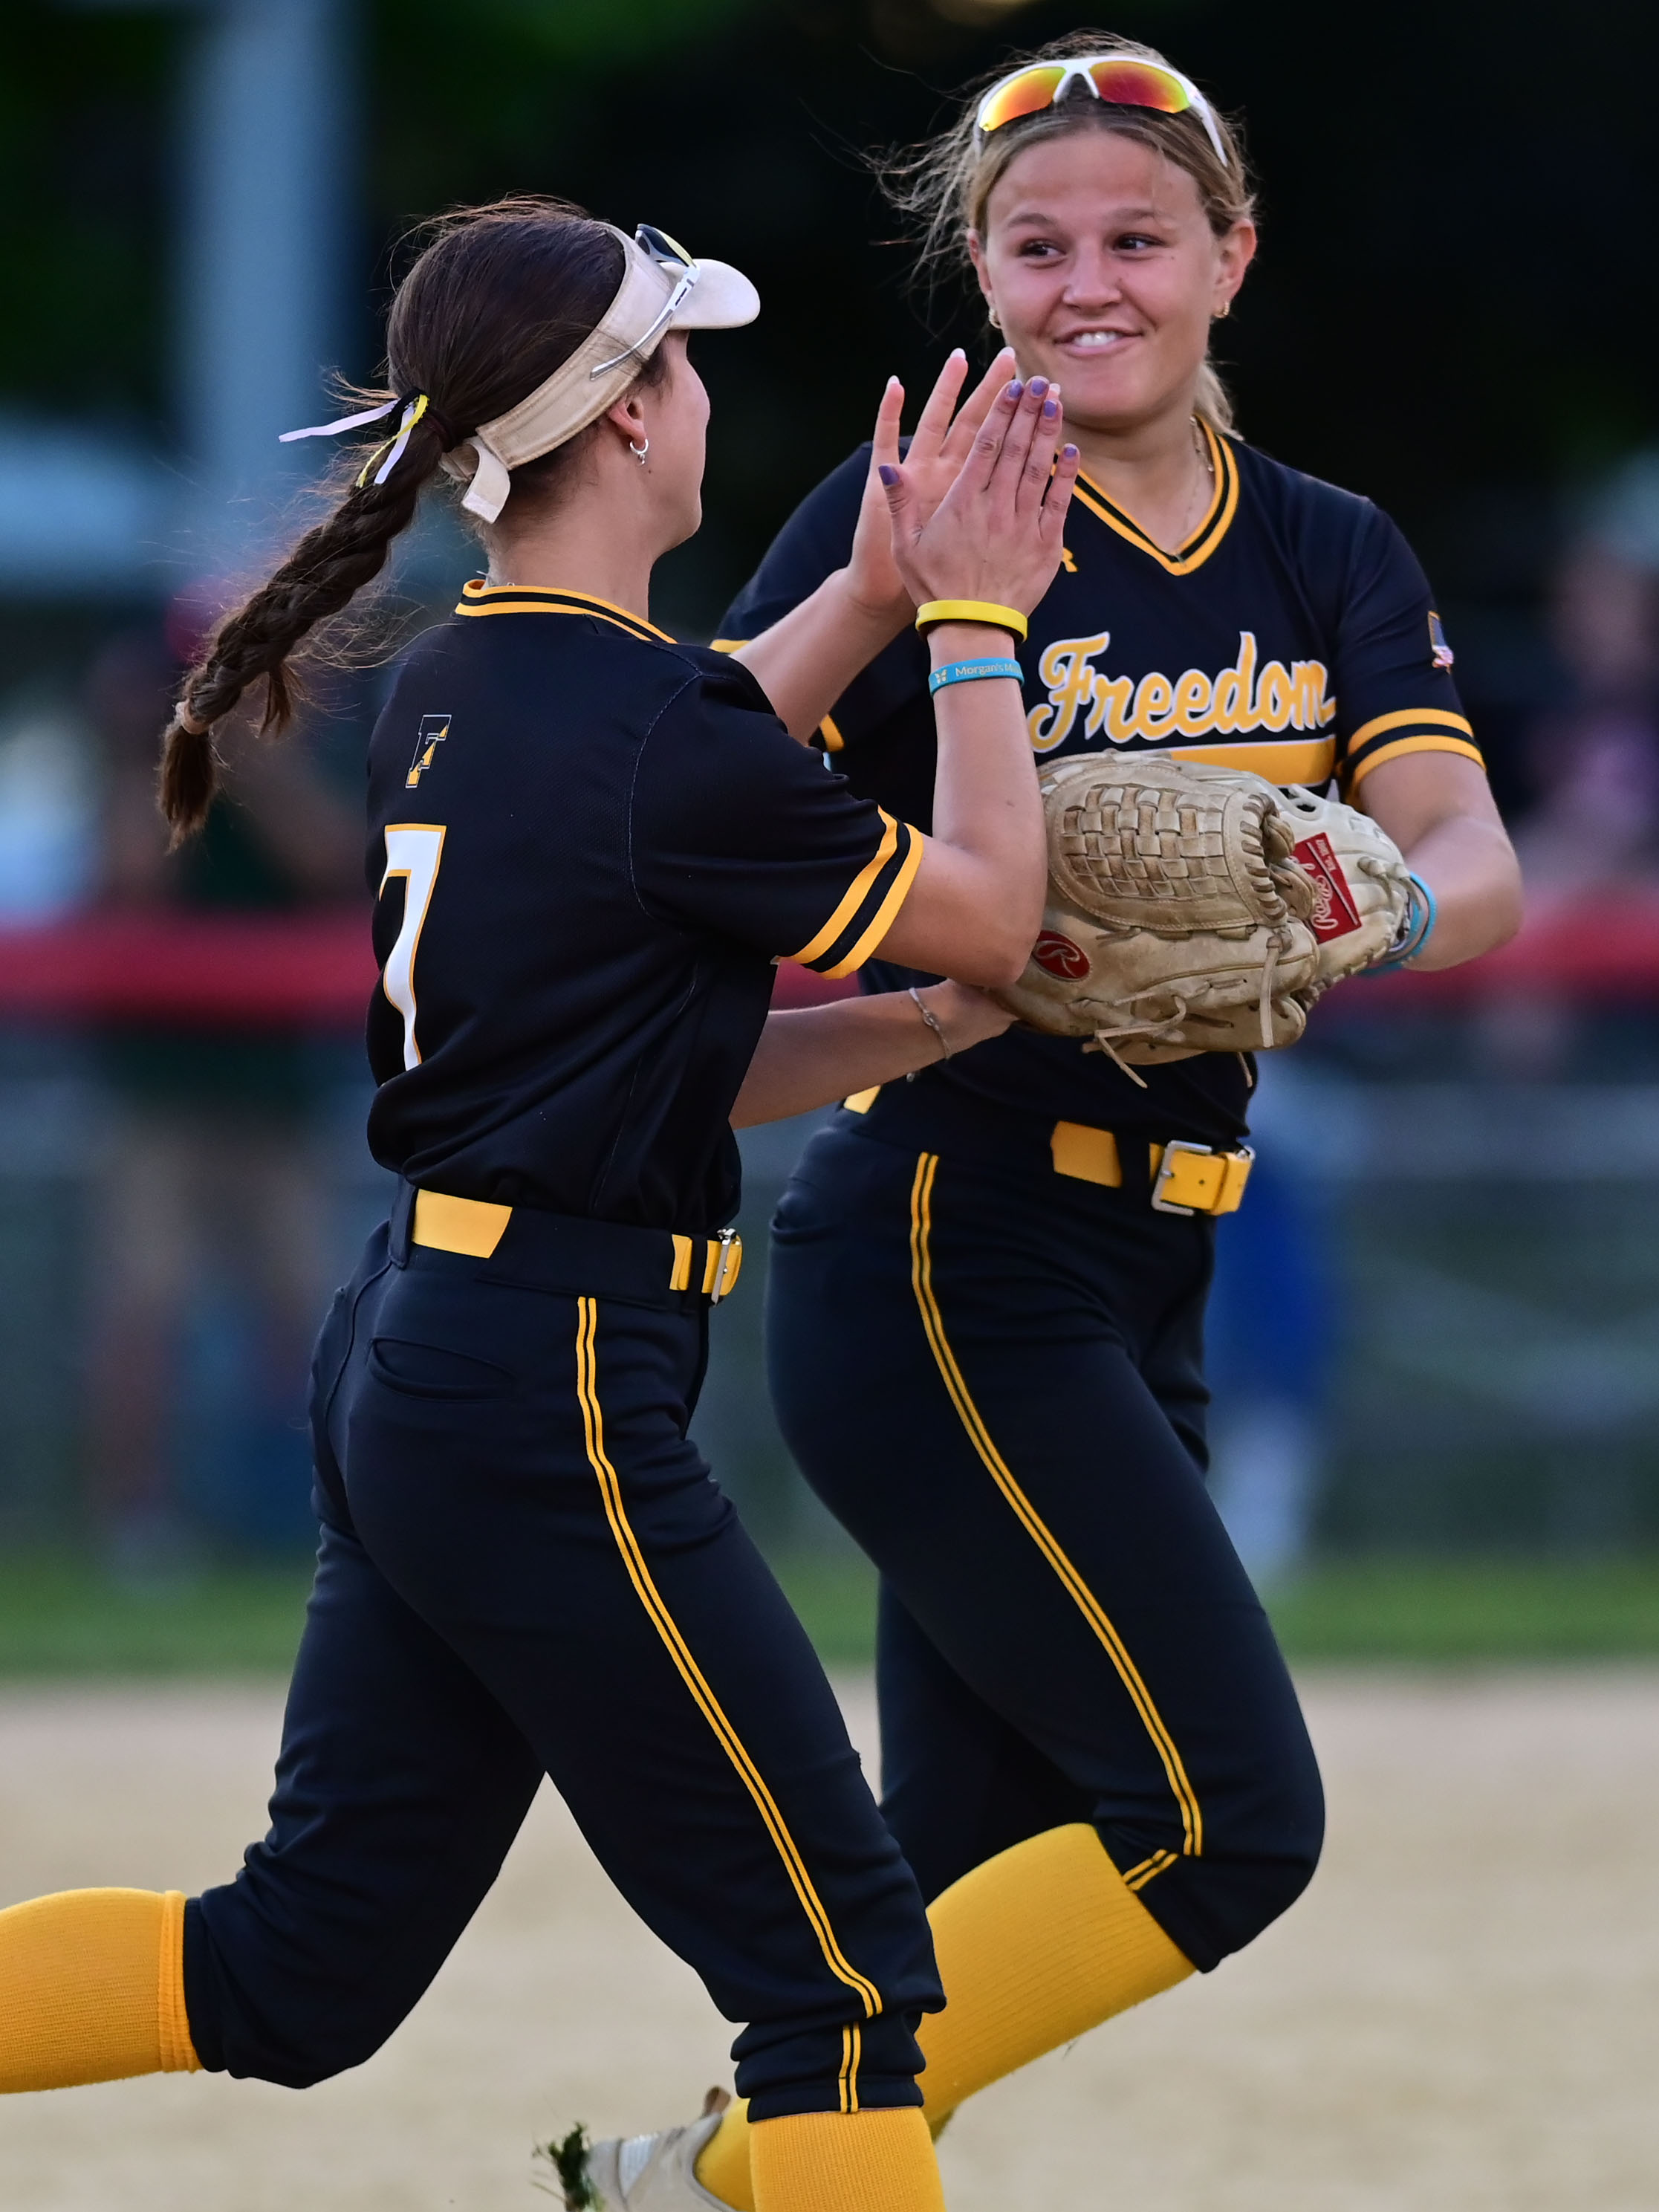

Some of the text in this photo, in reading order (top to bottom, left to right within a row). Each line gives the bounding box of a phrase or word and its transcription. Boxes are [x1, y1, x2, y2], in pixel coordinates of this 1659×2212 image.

[955, 664, 1003, 676] Morgan's
[1026, 631, 1336, 753] Freedom
[406, 714, 452, 788] F
[379, 823, 447, 1071] 7
